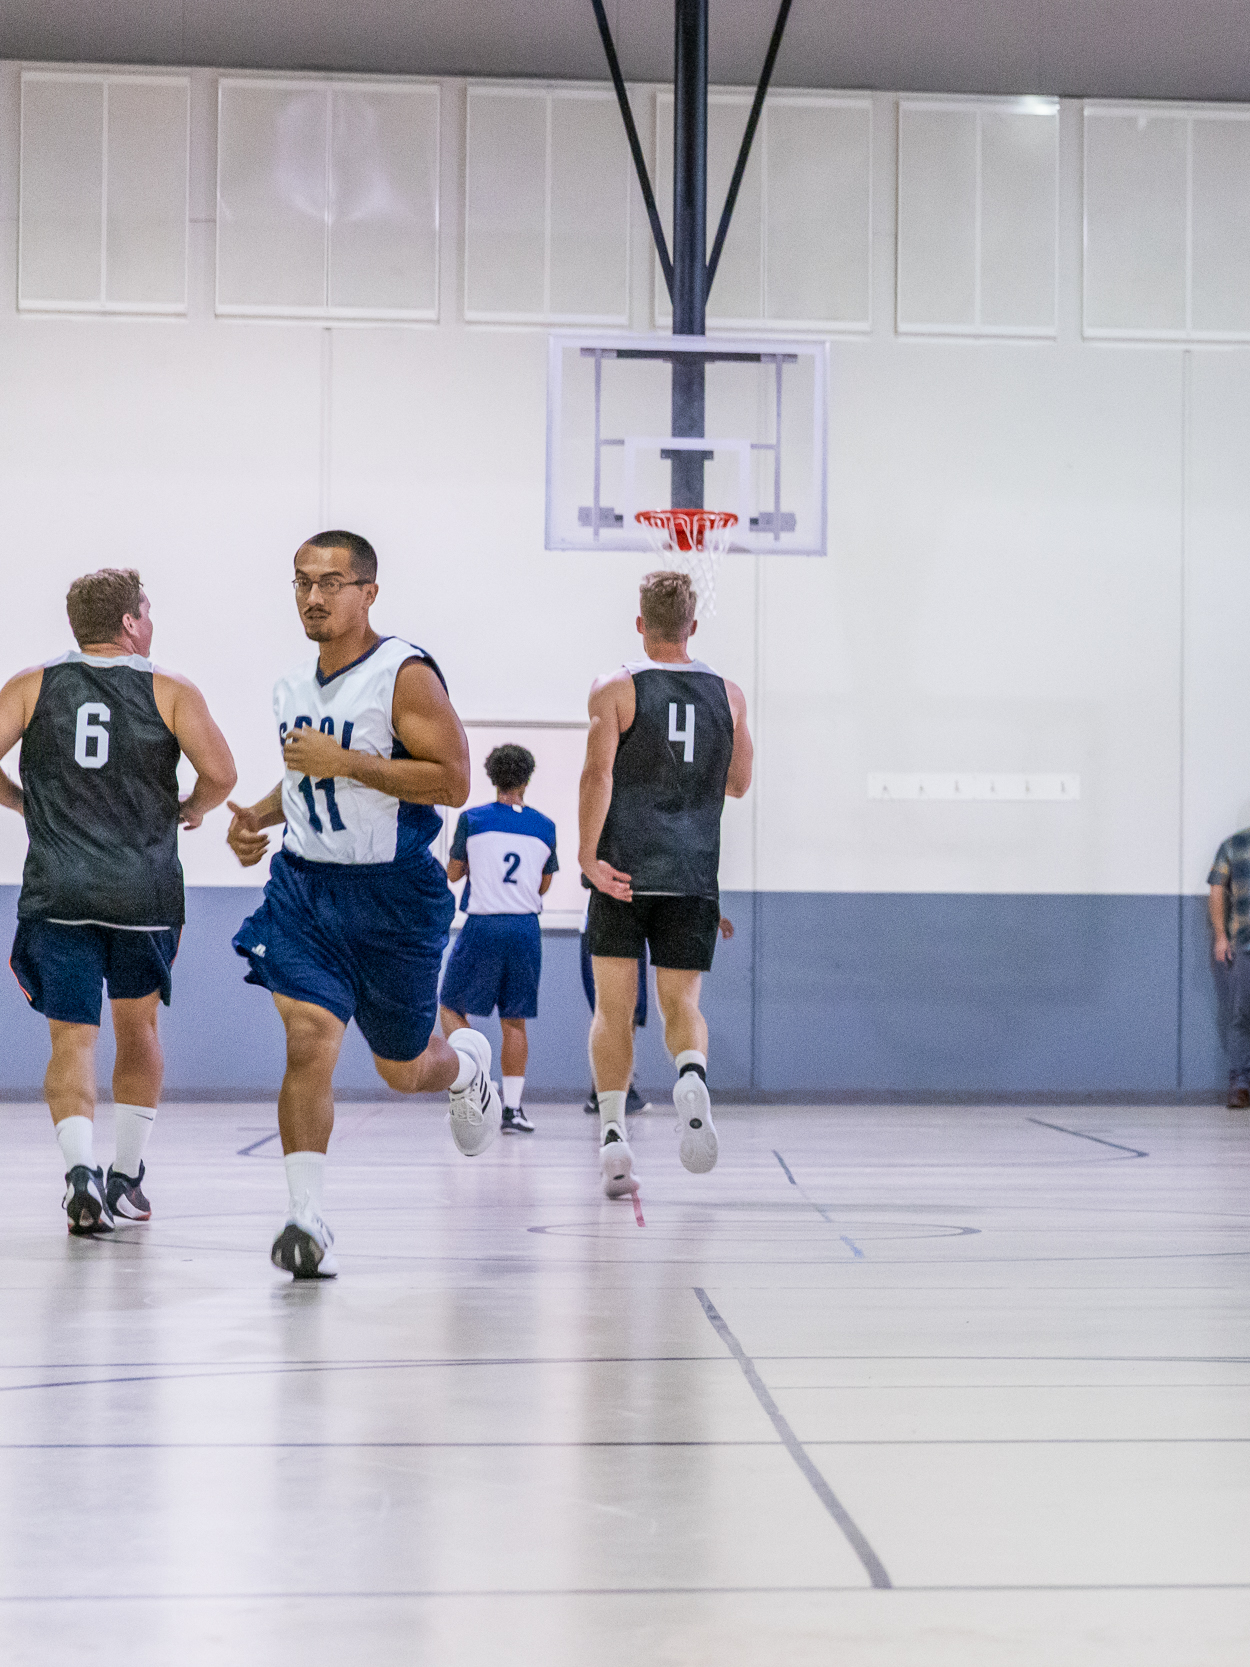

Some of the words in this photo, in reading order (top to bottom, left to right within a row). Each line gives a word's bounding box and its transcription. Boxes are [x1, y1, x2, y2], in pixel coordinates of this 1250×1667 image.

[74, 701, 111, 769] 6
[668, 702, 696, 763] 4
[298, 775, 347, 834] 11
[502, 851, 521, 884] 2
